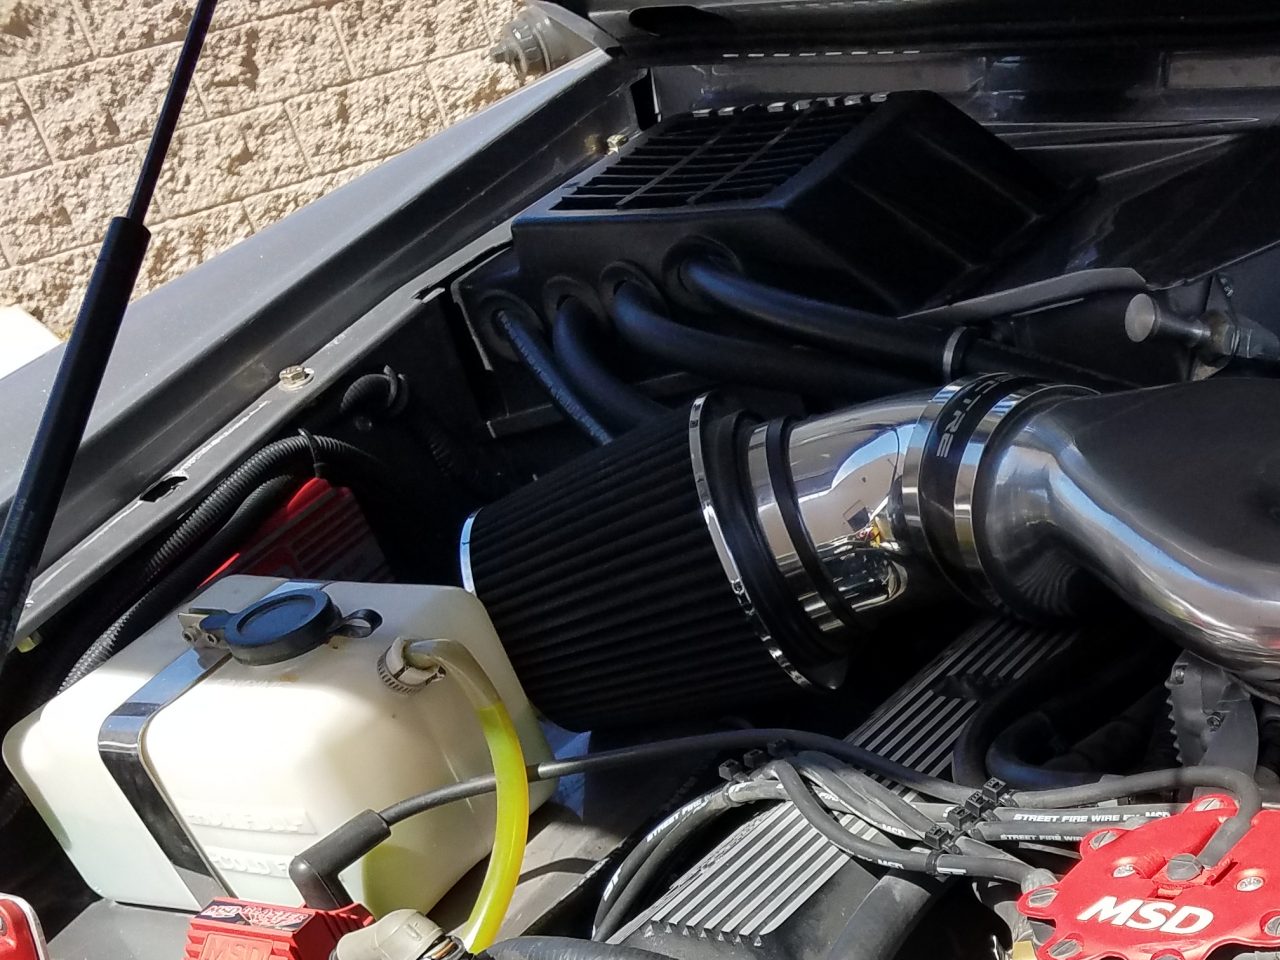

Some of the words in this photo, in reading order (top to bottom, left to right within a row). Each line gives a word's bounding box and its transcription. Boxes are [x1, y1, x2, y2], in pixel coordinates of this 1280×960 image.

[1013, 813, 1057, 823] STREET
[1061, 814, 1088, 823] FIRE
[1091, 813, 1119, 822] WIRE
[1000, 832, 1037, 841] STREET
[1039, 832, 1062, 841] FIRE
[1063, 833, 1085, 842] WIR
[1076, 895, 1214, 935] MSD
